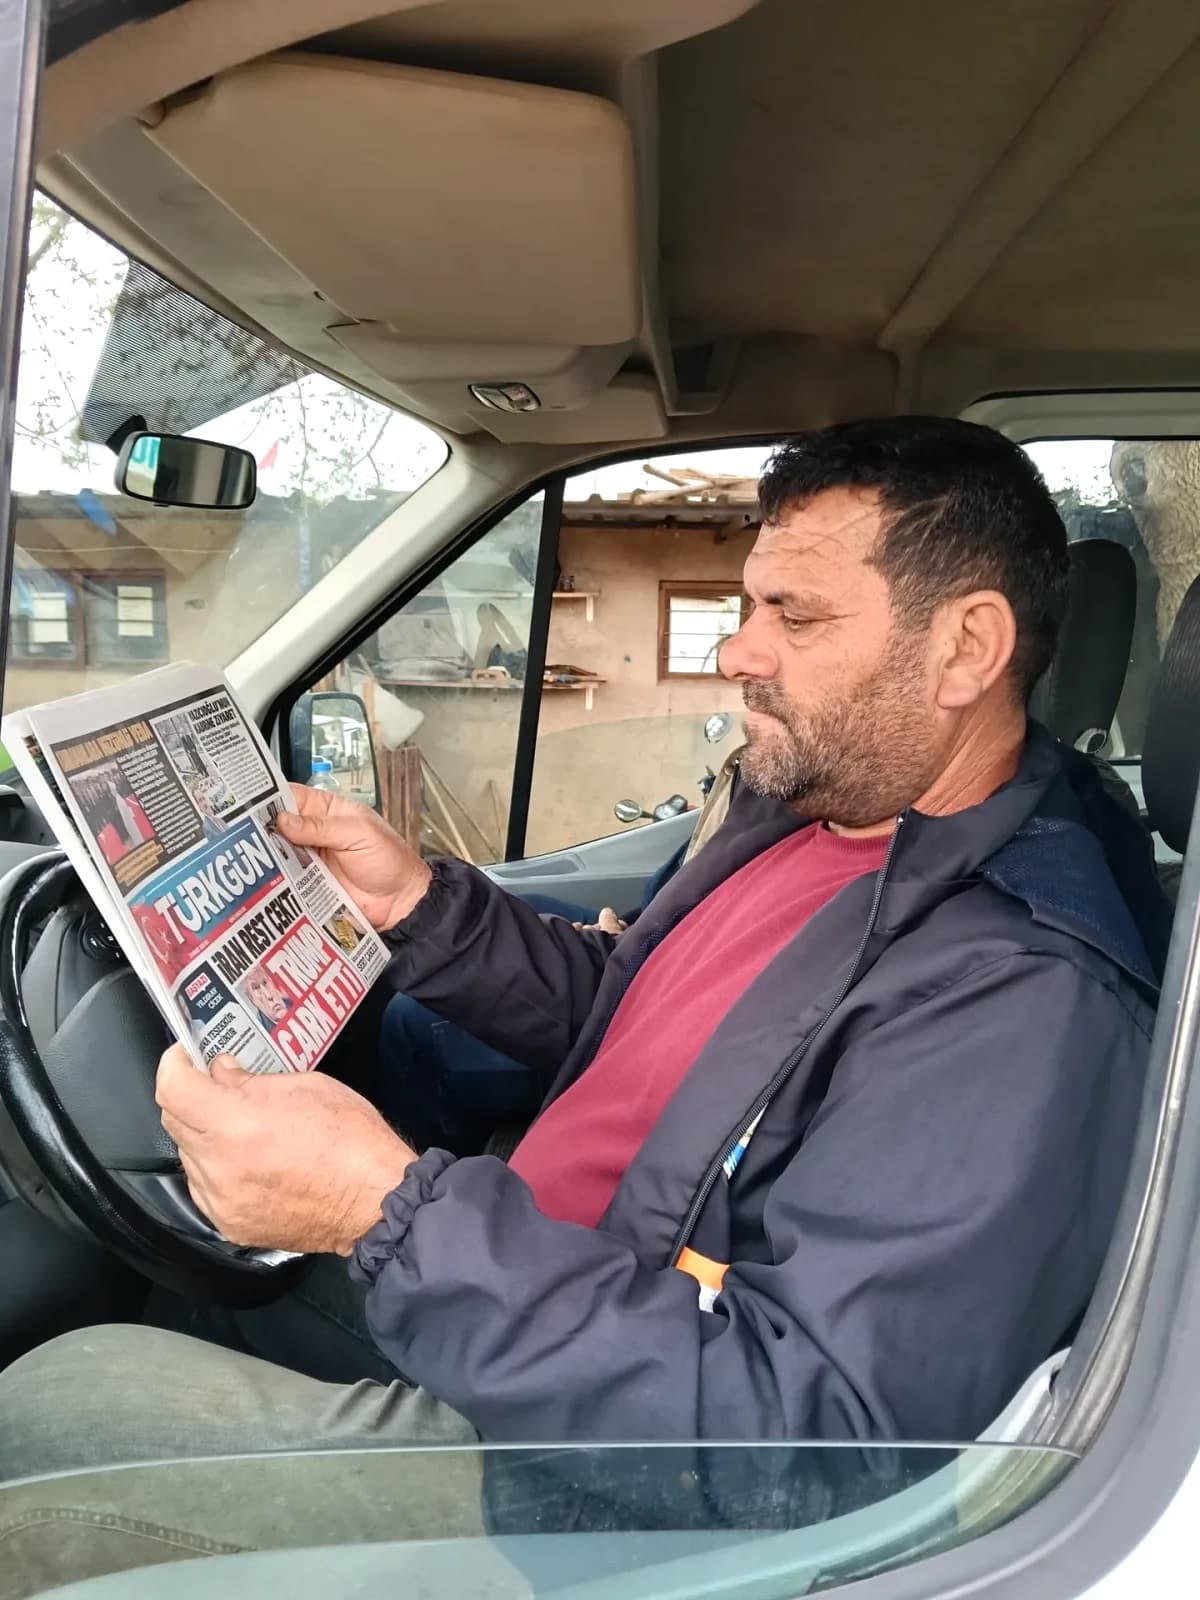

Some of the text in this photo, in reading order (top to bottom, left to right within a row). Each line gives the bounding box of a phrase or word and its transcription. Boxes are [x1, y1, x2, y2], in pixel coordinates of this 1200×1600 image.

[213, 708, 237, 726] ZİYARET
[153, 832, 275, 944] TÜRKGÜN
[211, 936, 253, 985] İRAN
[237, 911, 277, 959] REST
[264, 887, 303, 935] ÇEKTİ
[265, 923, 332, 999] TRUMP
[314, 958, 364, 1021] ETTİ
